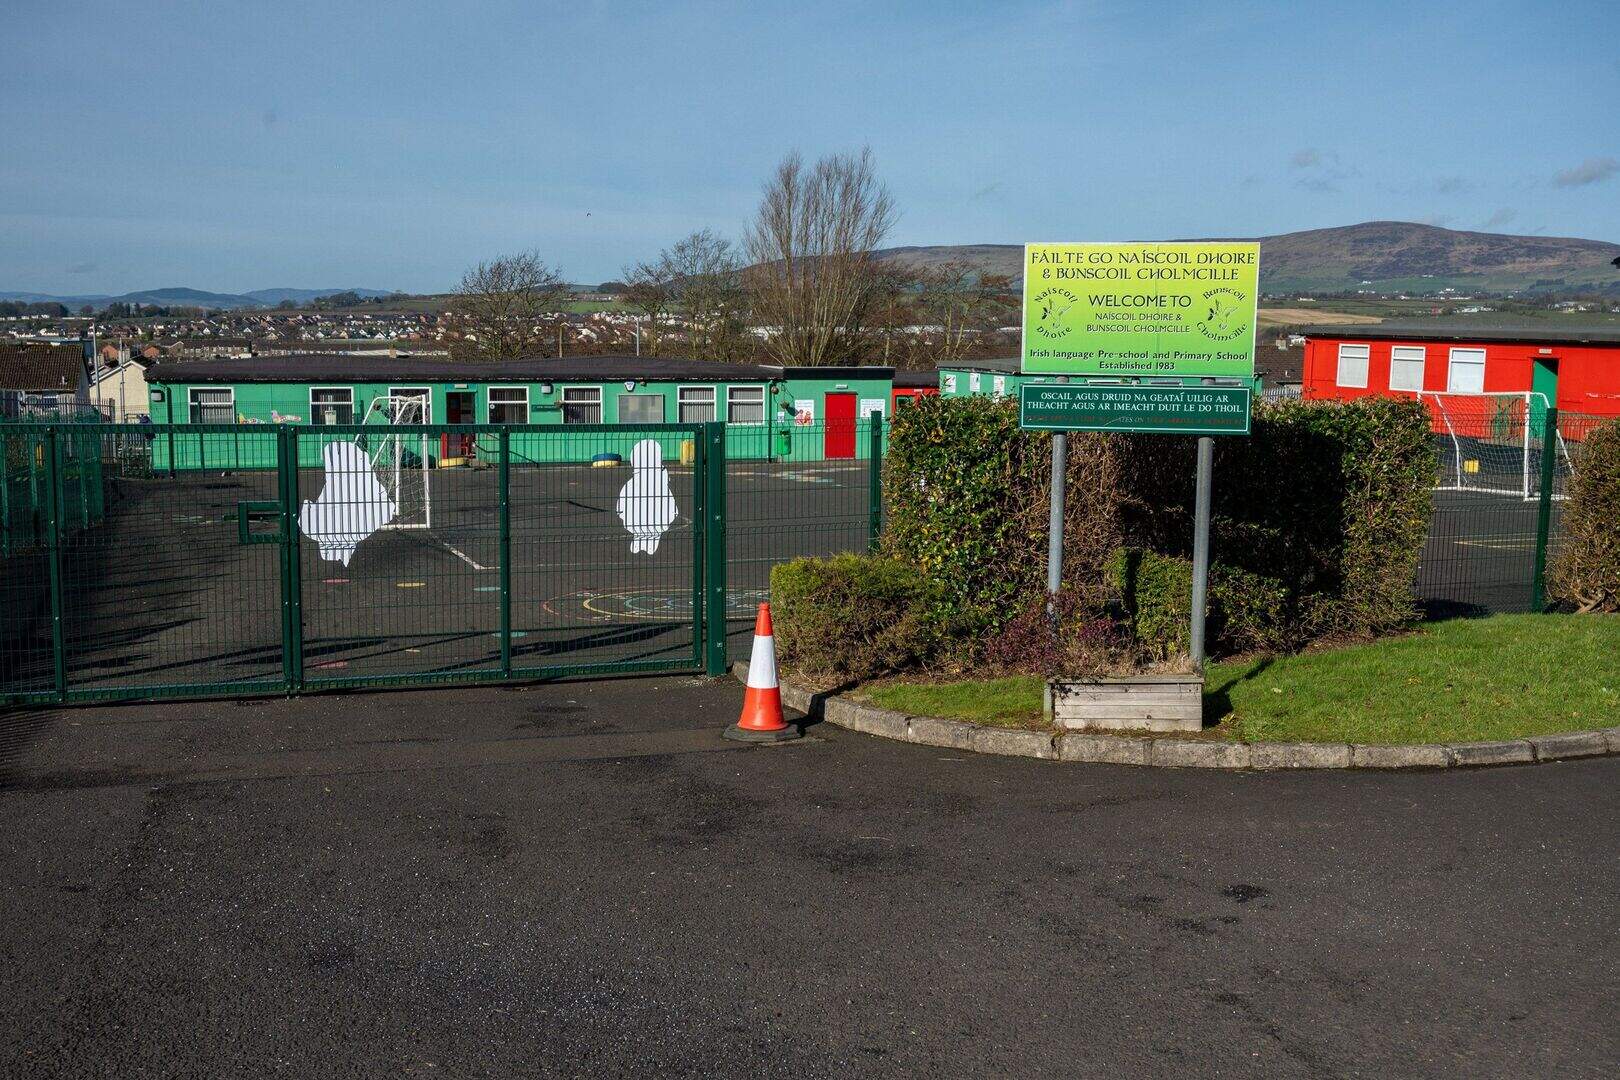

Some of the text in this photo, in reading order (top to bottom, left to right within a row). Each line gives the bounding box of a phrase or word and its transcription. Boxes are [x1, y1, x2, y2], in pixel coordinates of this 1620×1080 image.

[1032, 250, 1255, 264] FÁILTE GO NAÍSCOIL DHOIRE
[1043, 268, 1051, 279] &
[1137, 268, 1239, 280] CHOLMCILLE
[1202, 287, 1246, 301] Bunscoil
[1088, 295, 1192, 307] WELCOME TO
[1139, 313, 1174, 321] DHOIRE
[1036, 326, 1072, 339] Dhoire
[1086, 324, 1190, 333] BUNSCOIL CHOLMCILLE
[1196, 321, 1248, 341] Cholmcille
[1030, 349, 1248, 361] Irish language Pre-school and Primary School
[1099, 361, 1175, 370] Established 1983
[1041, 392, 1072, 400] OSCAIL
[1075, 393, 1099, 401] AGUS
[1101, 393, 1131, 401] DRUID
[1134, 394, 1147, 402] NA
[1187, 394, 1213, 402] UILIG
[1215, 395, 1229, 403] AR
[1026, 401, 1069, 409] THEACHT
[1071, 402, 1095, 410] AGUS
[1113, 403, 1156, 411] IMEACHT
[1158, 404, 1182, 412] DUIT
[1183, 404, 1195, 412] LE
[1198, 404, 1212, 412] DO
[1215, 405, 1244, 413] THOIL.
